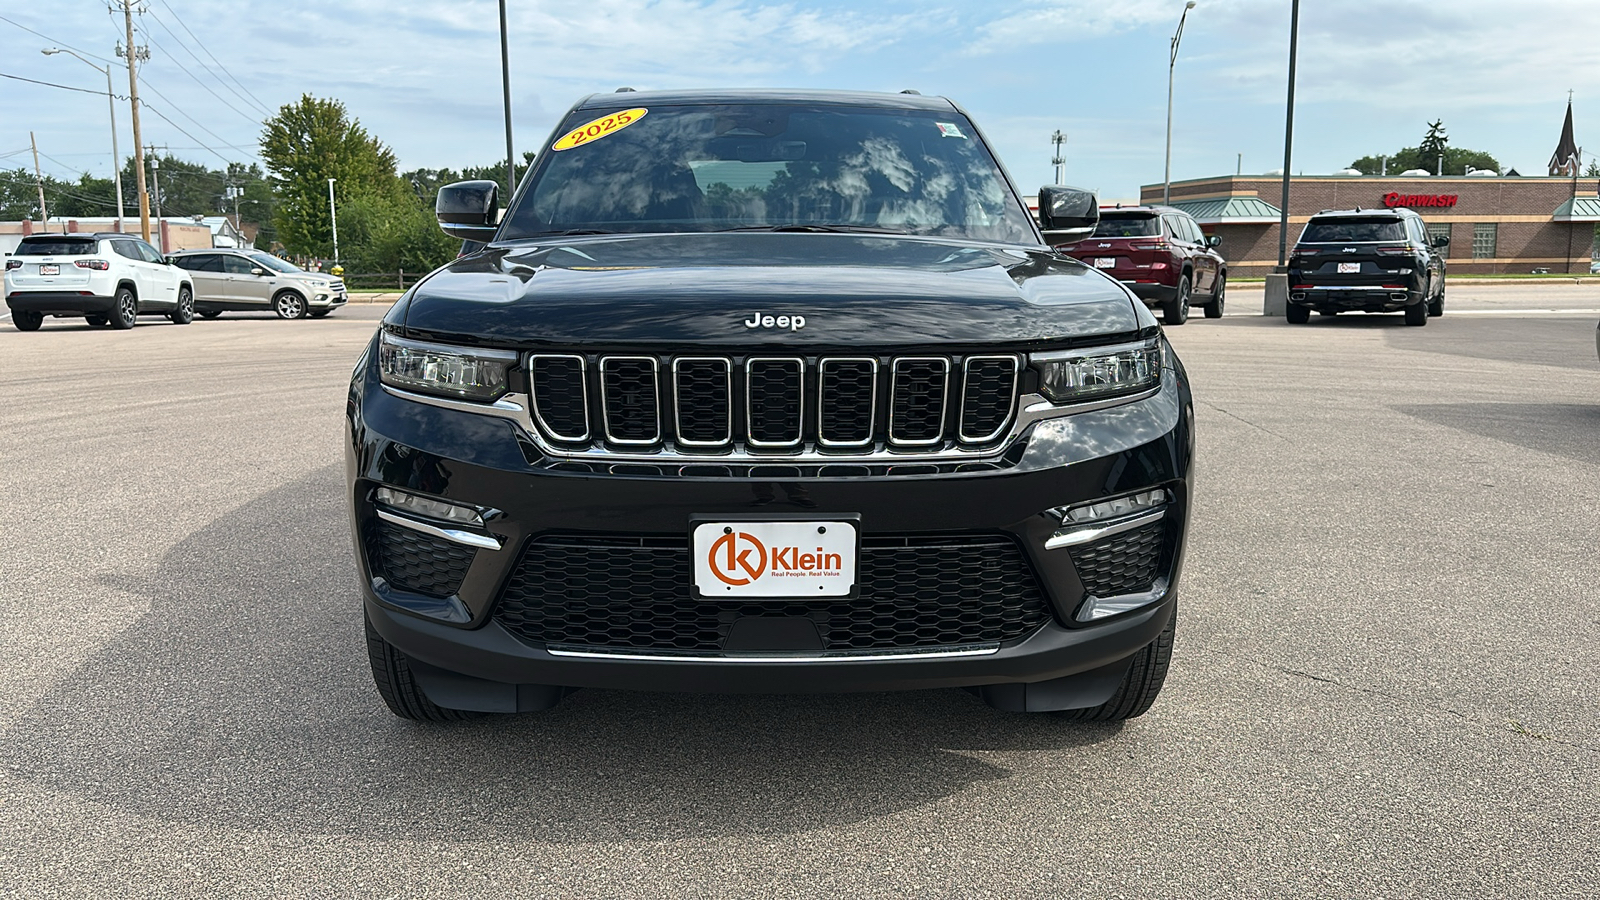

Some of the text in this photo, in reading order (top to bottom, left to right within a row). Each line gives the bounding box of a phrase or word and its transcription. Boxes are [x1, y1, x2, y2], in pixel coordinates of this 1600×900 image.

[571, 112, 631, 145] 2025
[1385, 192, 1458, 207] CARWASH
[745, 312, 806, 331] Jeep
[771, 547, 842, 571] Klein
